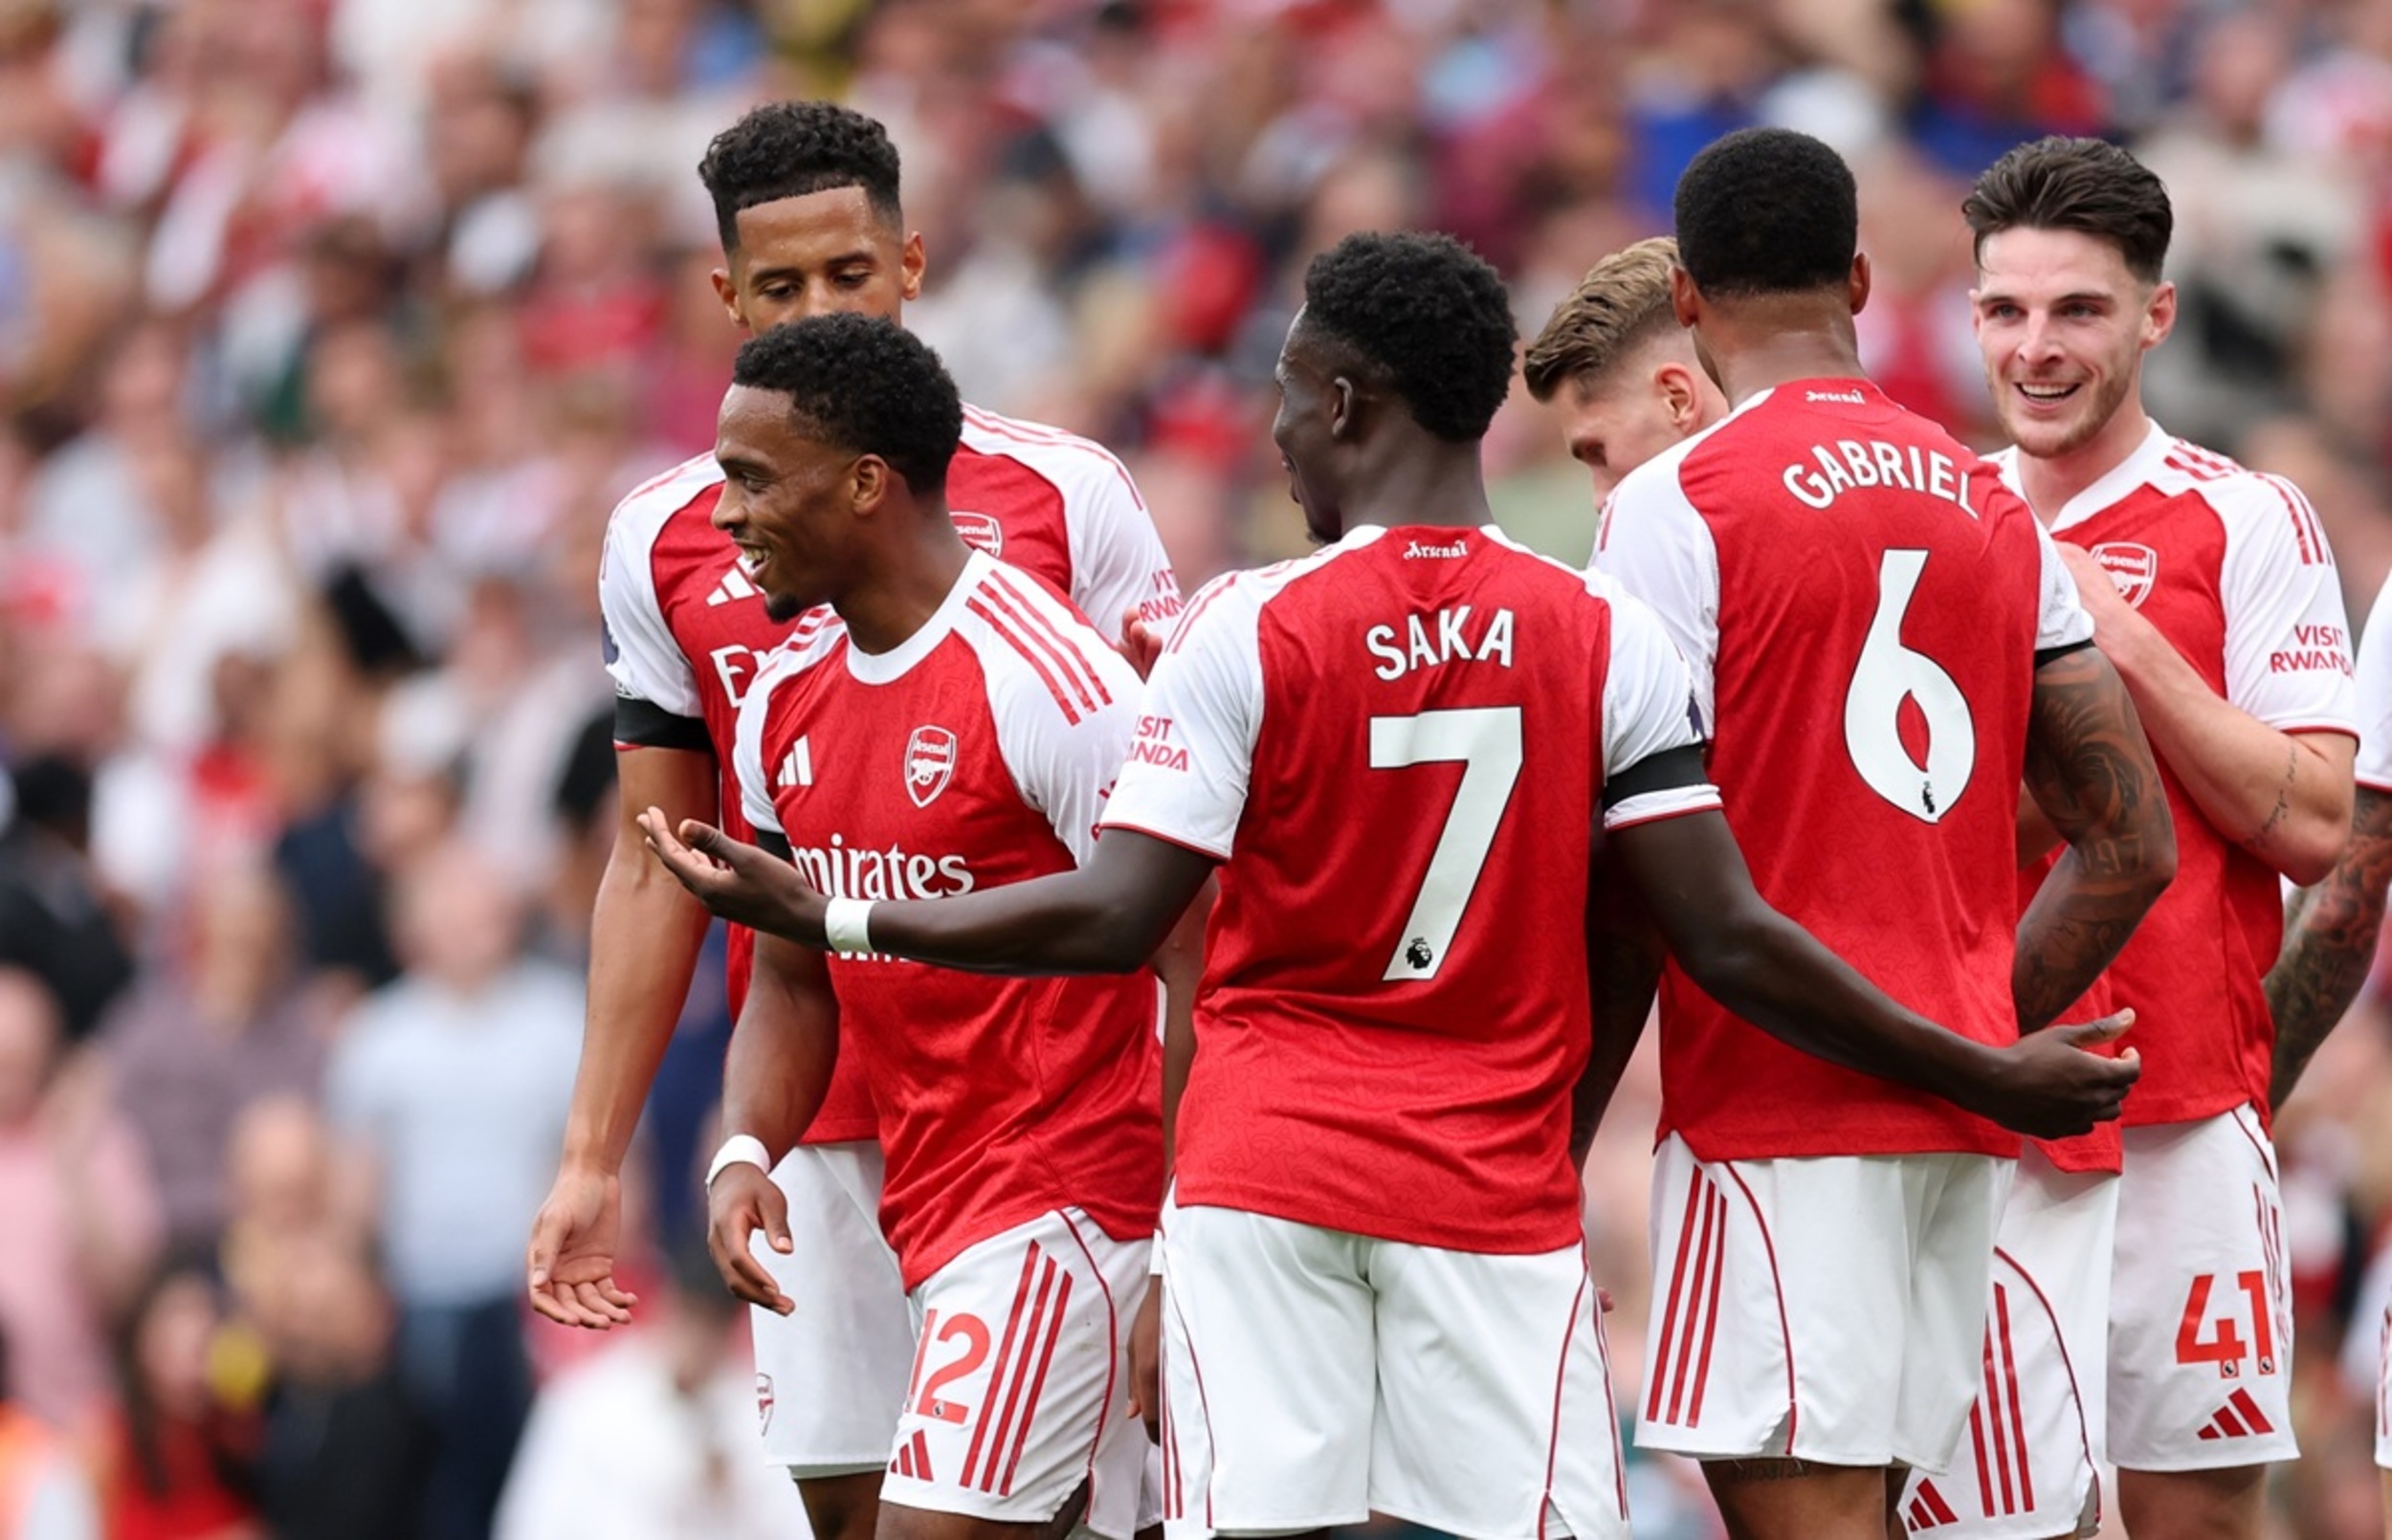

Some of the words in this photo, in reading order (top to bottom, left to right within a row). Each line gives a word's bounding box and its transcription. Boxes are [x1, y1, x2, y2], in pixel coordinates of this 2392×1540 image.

[1783, 439, 1980, 520] GABRIEL
[1402, 539, 1469, 561] Arsenal
[1366, 605, 1515, 682] SAKA
[1844, 547, 1977, 825] 6
[791, 832, 975, 901] mirates
[1368, 705, 1524, 982] 7
[2176, 1269, 2275, 1379] 41
